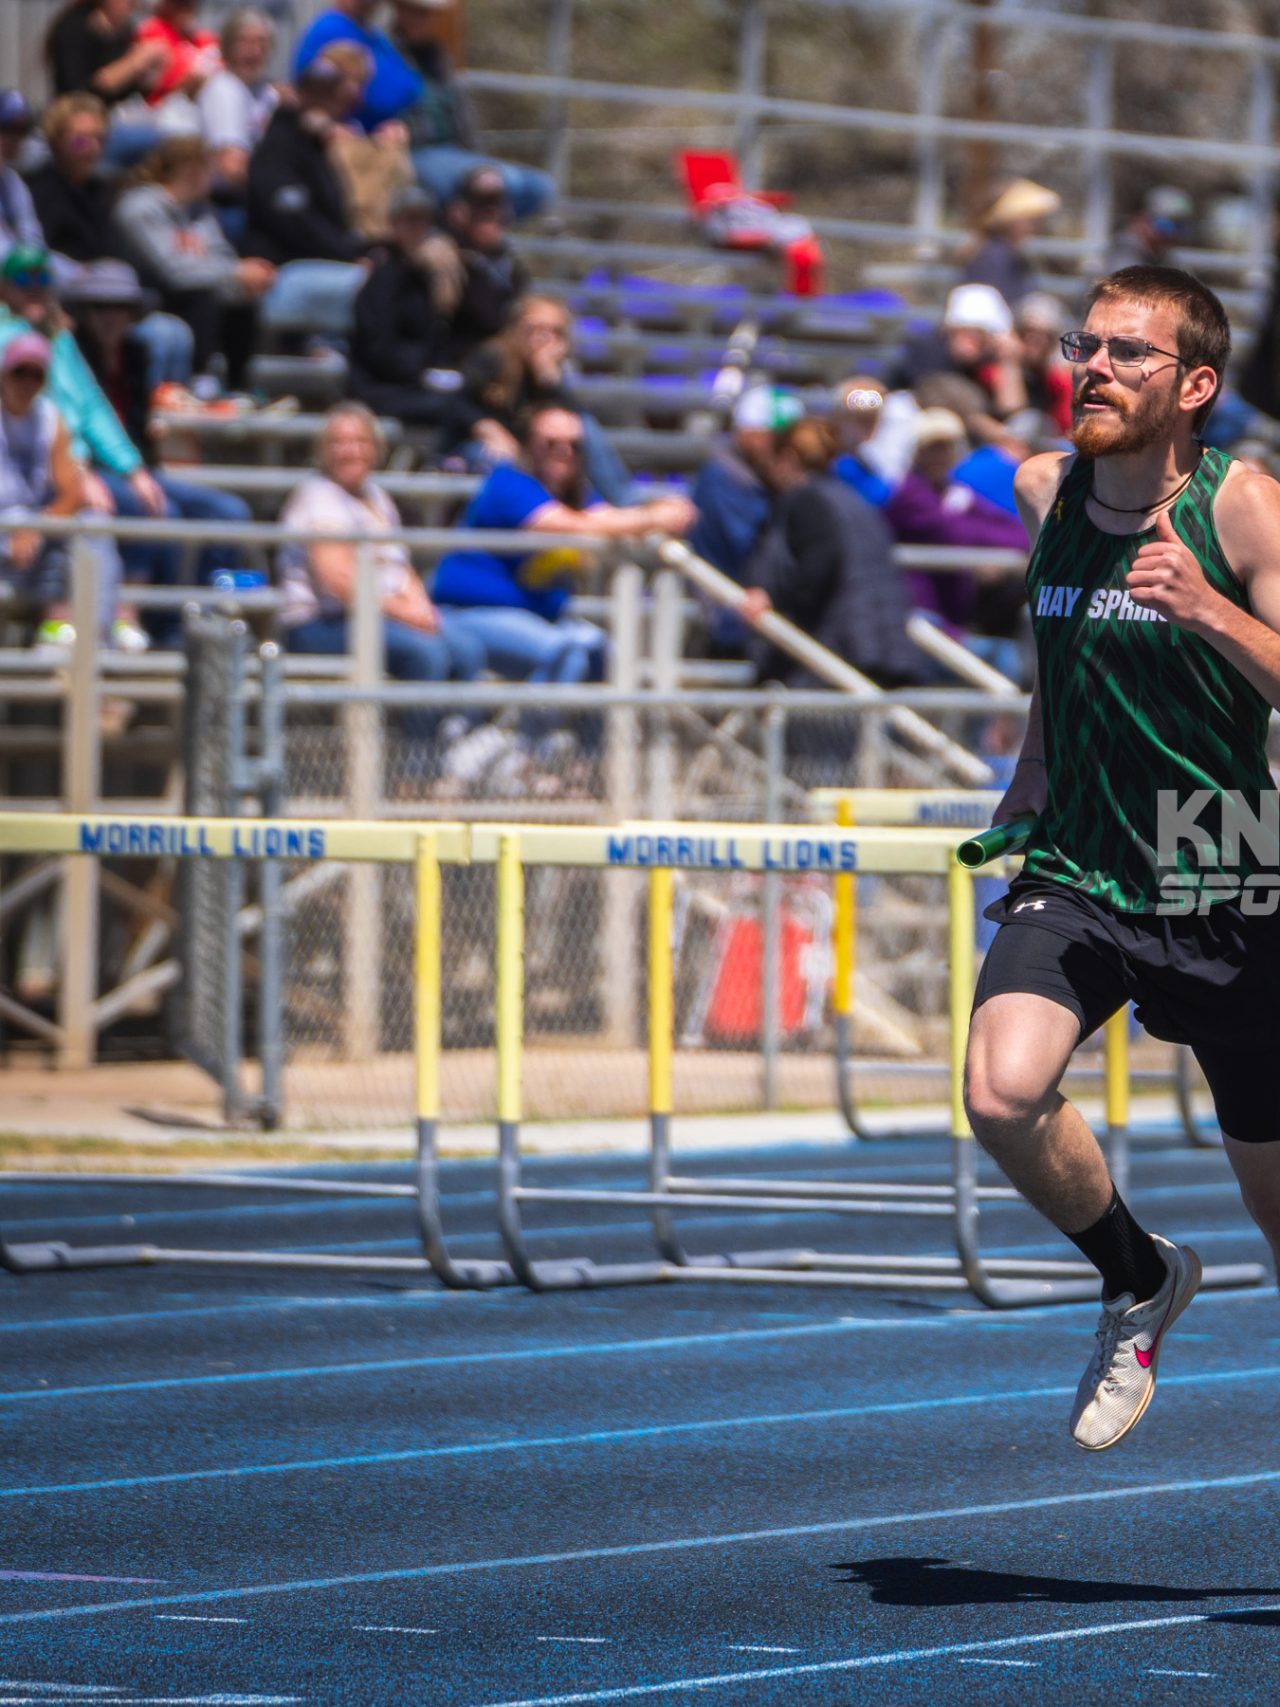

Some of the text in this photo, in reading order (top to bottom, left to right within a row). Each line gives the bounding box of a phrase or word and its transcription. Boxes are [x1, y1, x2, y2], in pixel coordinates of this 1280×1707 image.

[1036, 586, 1083, 617] HAY
[79, 823, 327, 858] MORRILL LIONS
[607, 834, 858, 871] MORRILL LIONS
